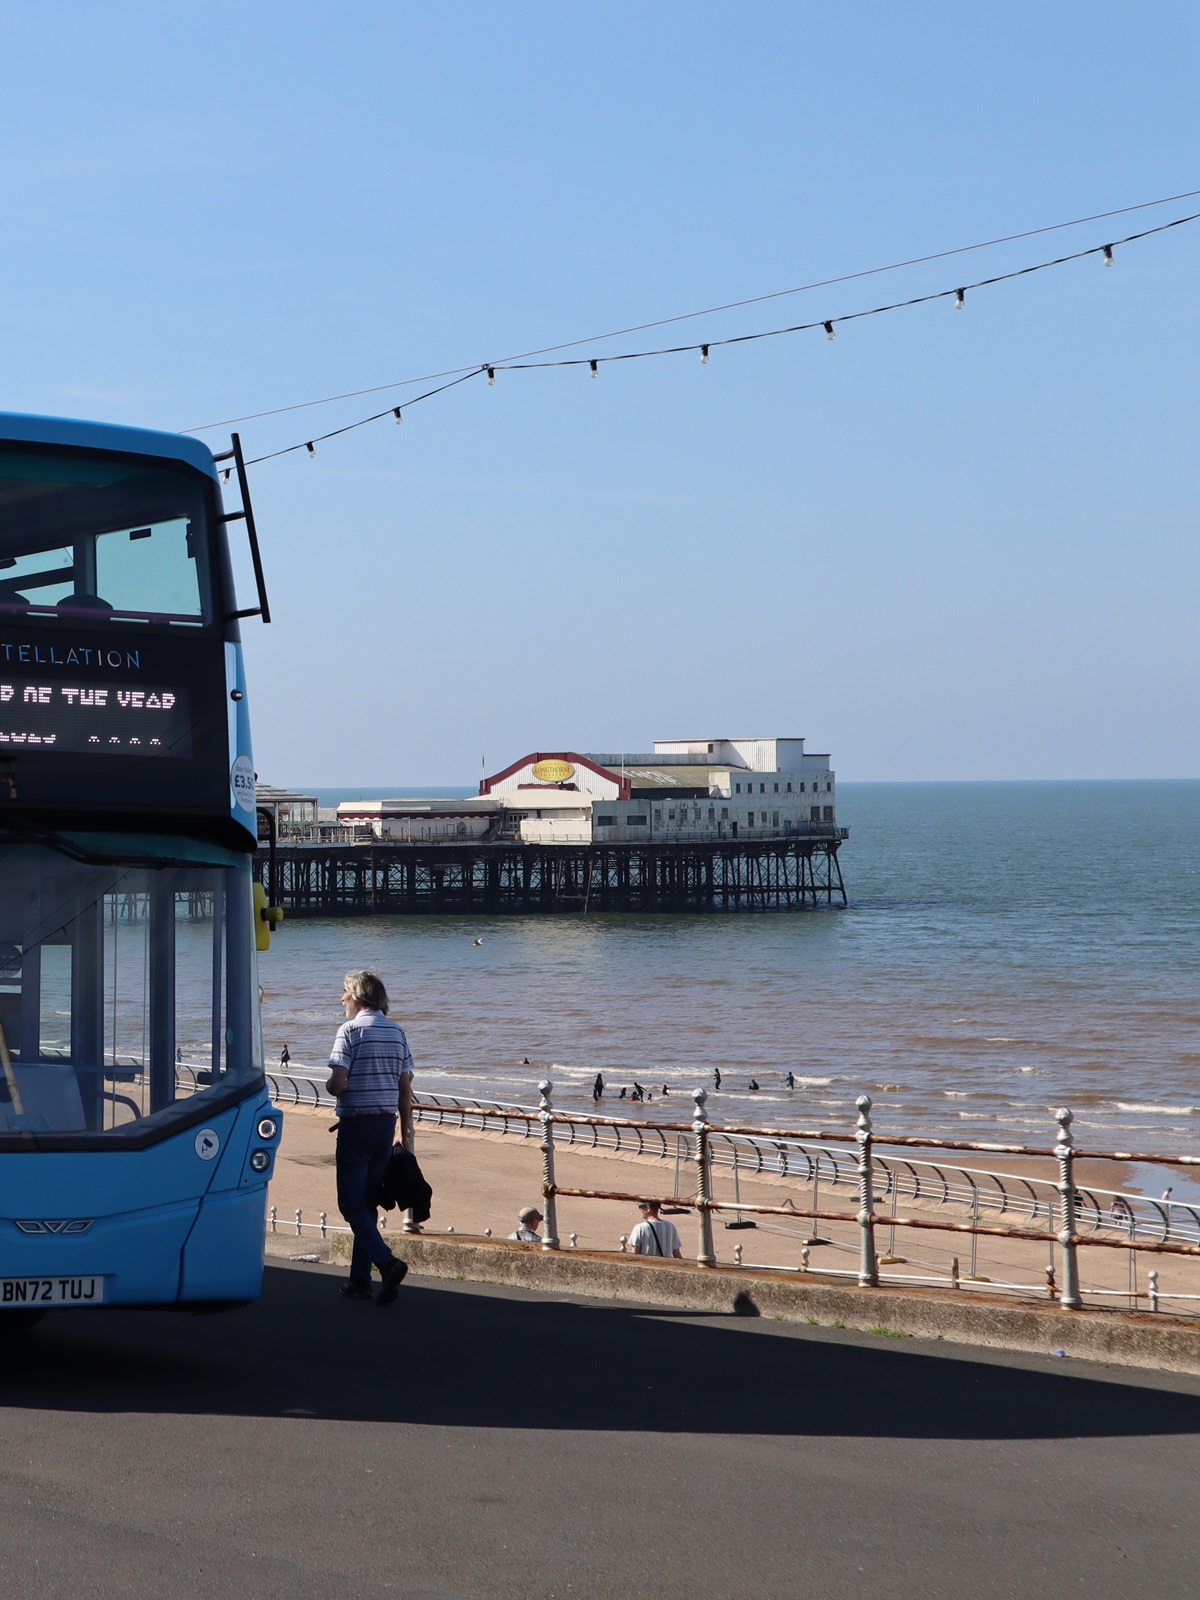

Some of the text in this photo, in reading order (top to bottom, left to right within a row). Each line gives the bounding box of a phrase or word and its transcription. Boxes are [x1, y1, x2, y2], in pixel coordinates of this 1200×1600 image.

[534, 766, 571, 774] LONGTHORNE
[2, 1279, 95, 1302] BN72 TUJ
